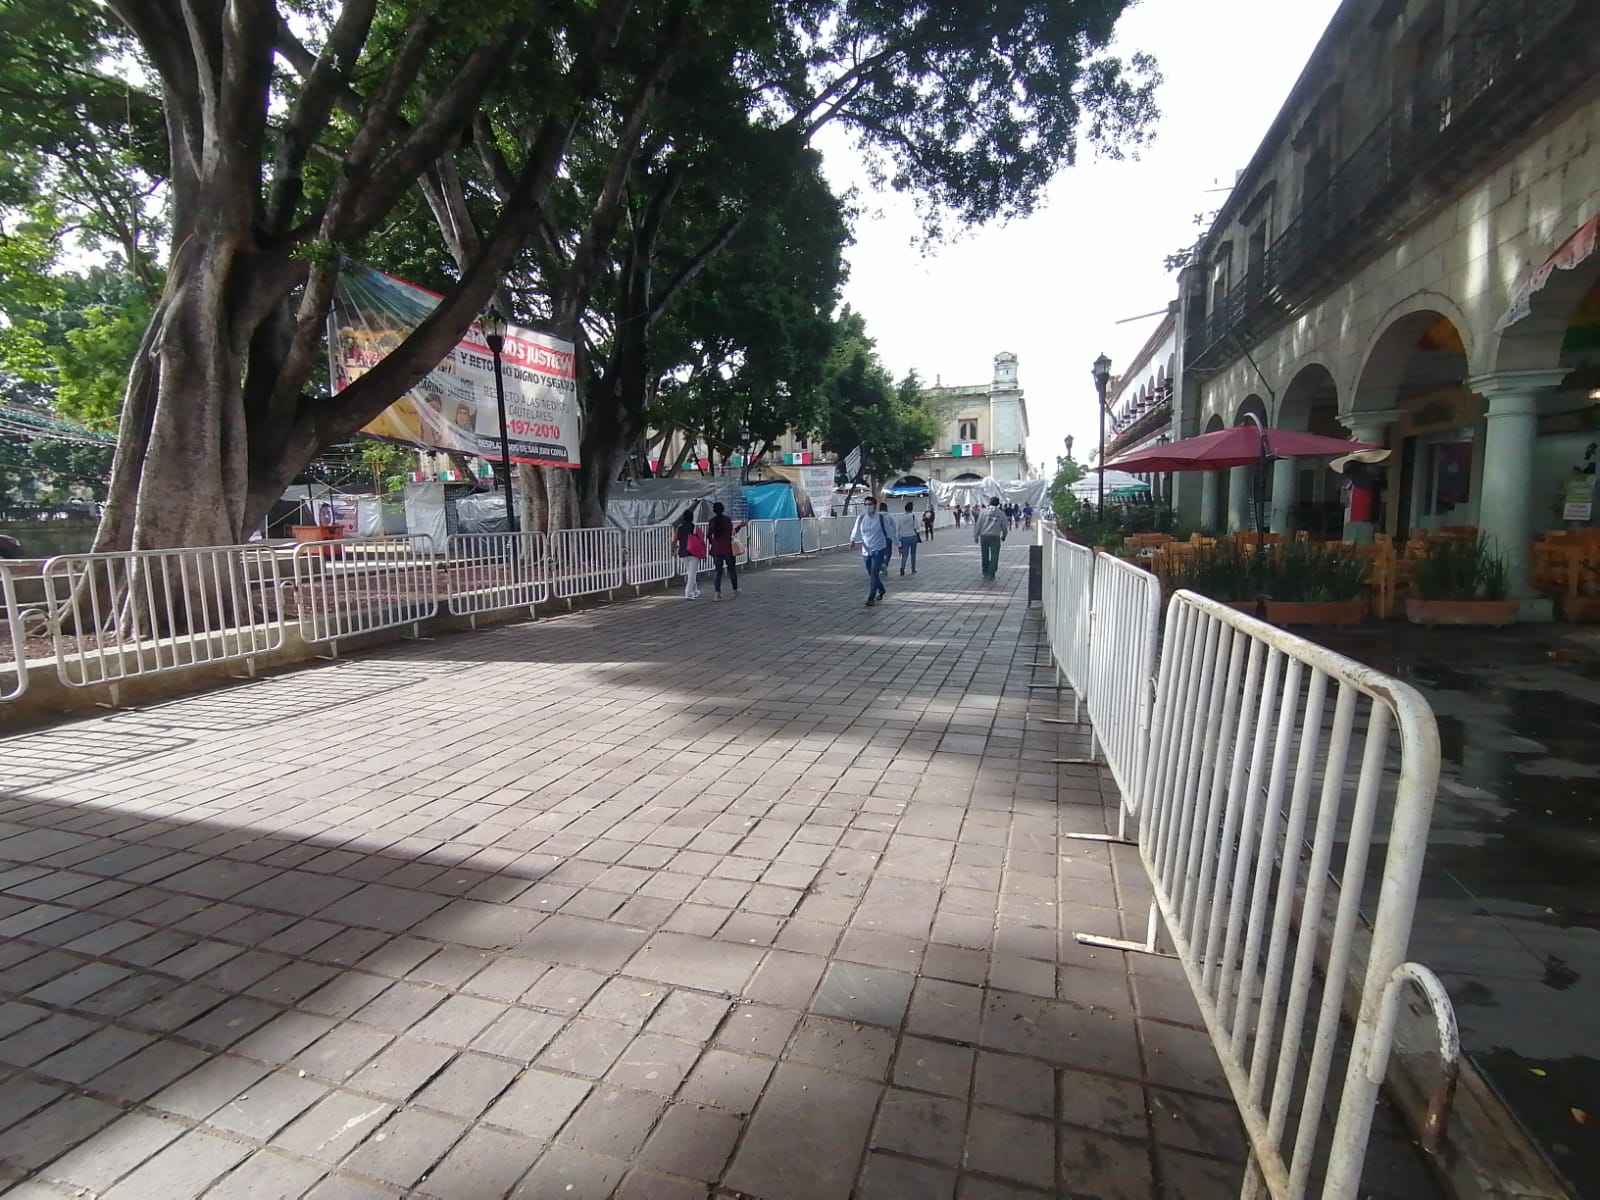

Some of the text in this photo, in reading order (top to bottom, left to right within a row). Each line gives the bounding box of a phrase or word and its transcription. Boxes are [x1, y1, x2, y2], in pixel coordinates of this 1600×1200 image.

[470, 354, 512, 377] RETONO
[513, 367, 540, 384] DIGNO
[540, 375, 546, 386] Y
[483, 386, 520, 404] RESETO
